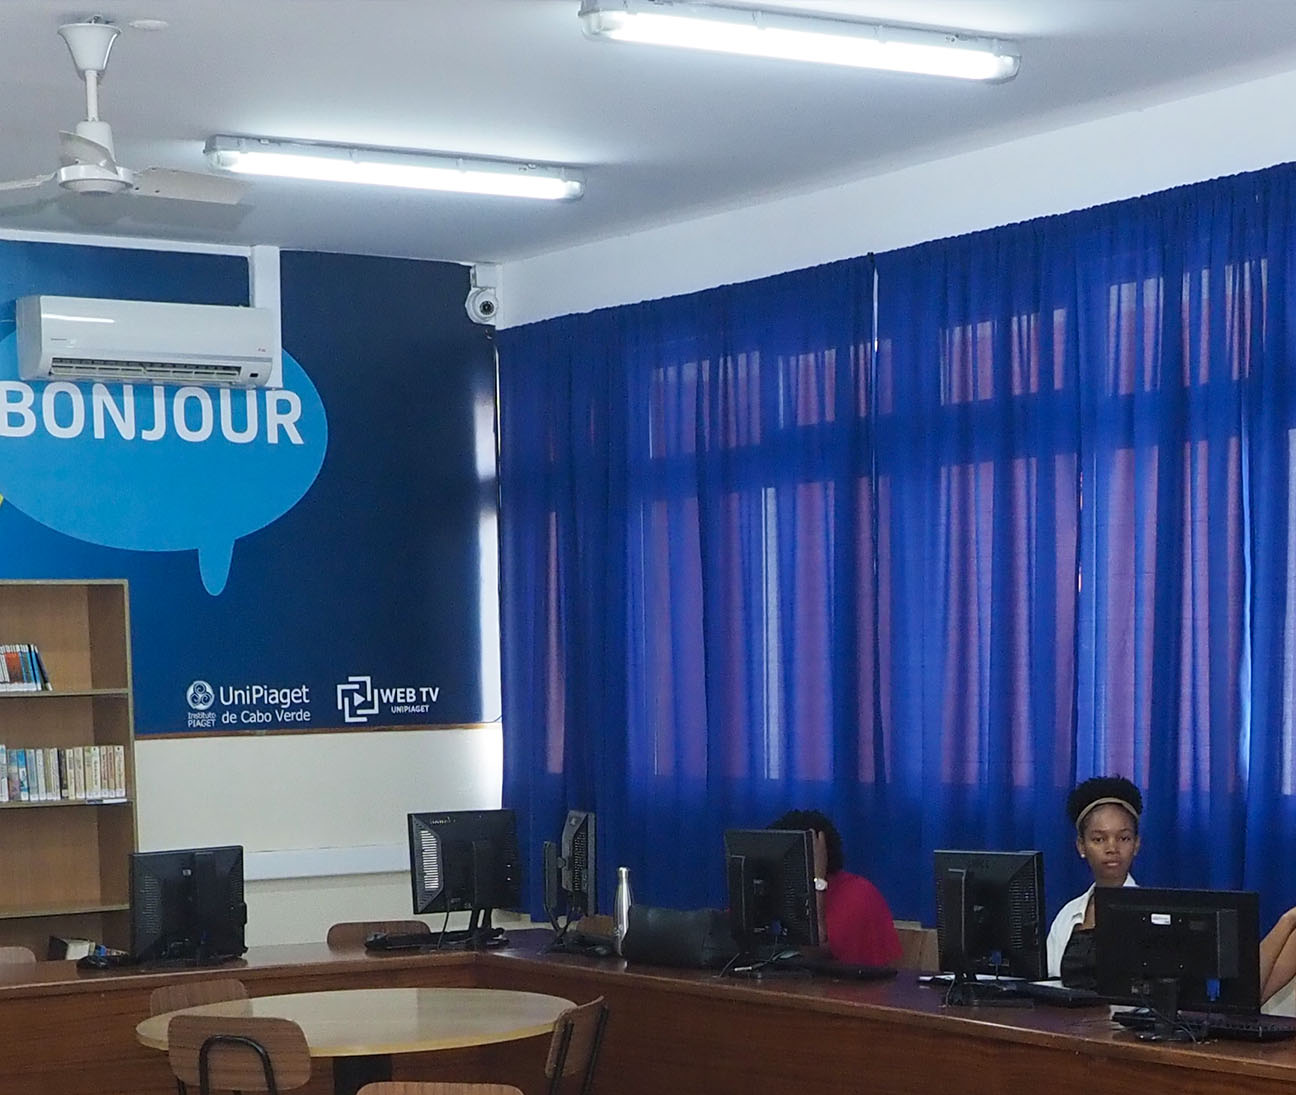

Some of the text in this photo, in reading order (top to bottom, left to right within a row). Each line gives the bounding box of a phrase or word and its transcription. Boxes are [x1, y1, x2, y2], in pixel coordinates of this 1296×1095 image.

[219, 684, 310, 708] UniPiaget
[380, 687, 440, 703] WEB TV
[221, 708, 311, 723] de Cabo Verde
[391, 704, 430, 713] UNIPIAGET
[187, 719, 216, 728] PIAGET
